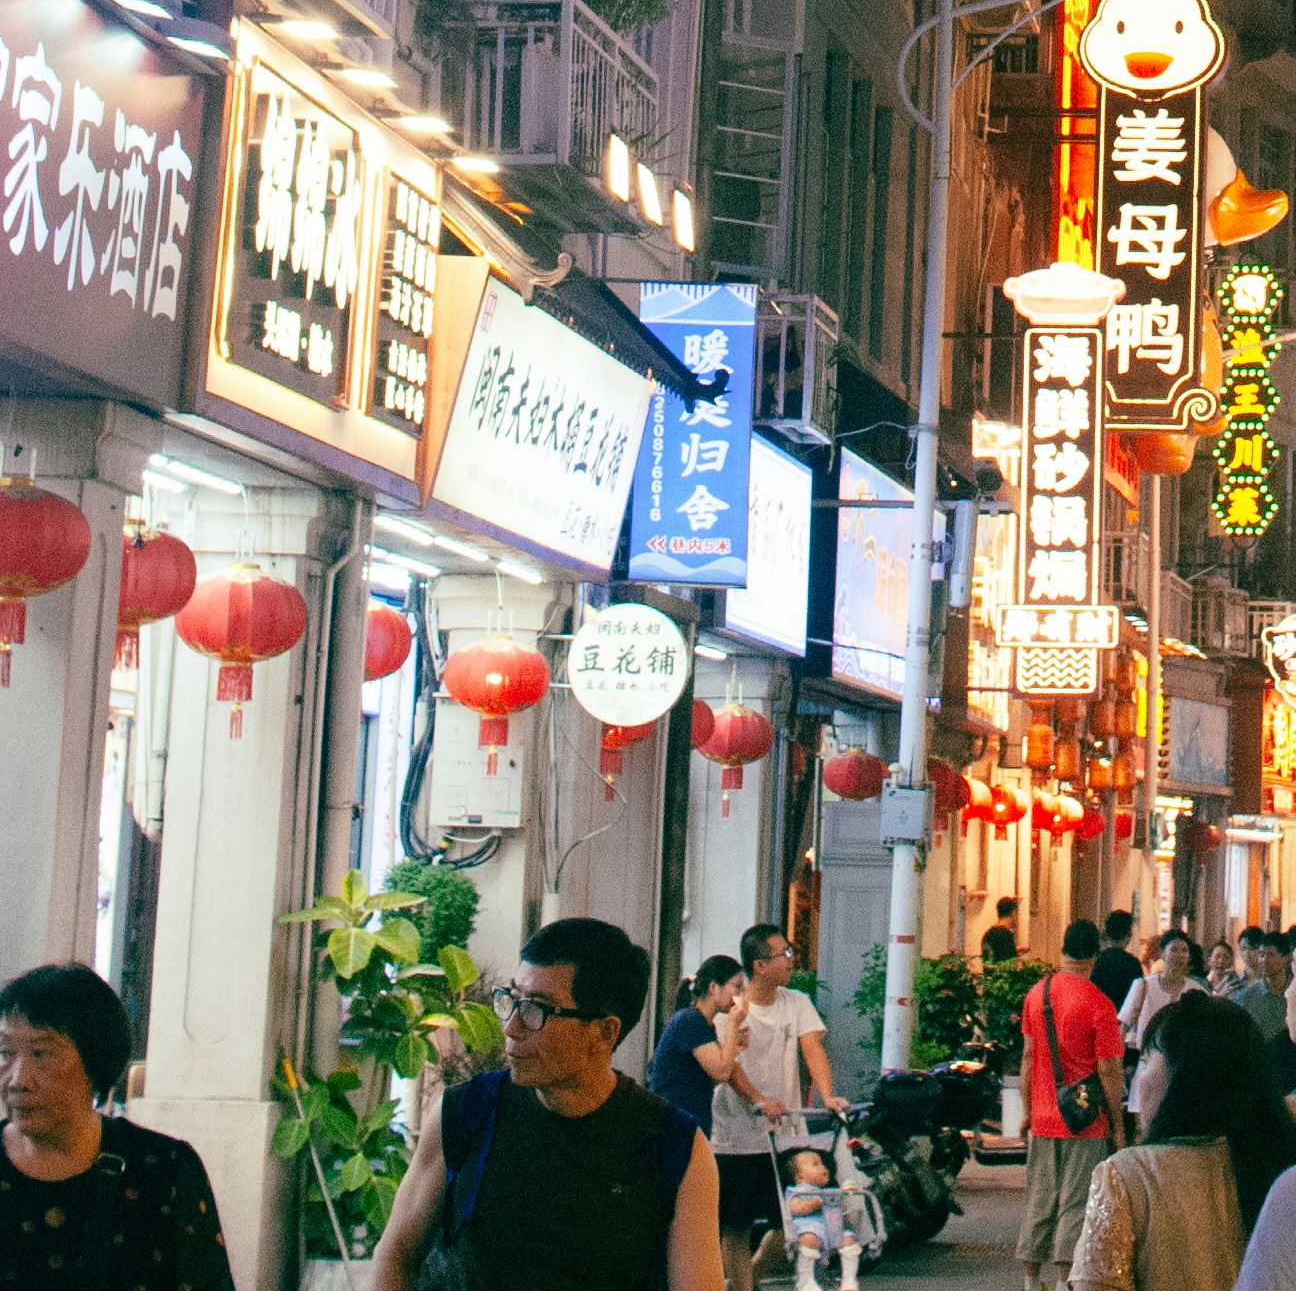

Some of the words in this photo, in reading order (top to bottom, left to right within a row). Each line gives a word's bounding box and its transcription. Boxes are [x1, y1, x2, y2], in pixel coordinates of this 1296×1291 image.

[0, 34, 193, 321] 家乐酒店
[1105, 107, 1189, 376] 姜母鸭
[576, 644, 677, 676] 豆花铺
[597, 620, 662, 636] 闽南夫妇
